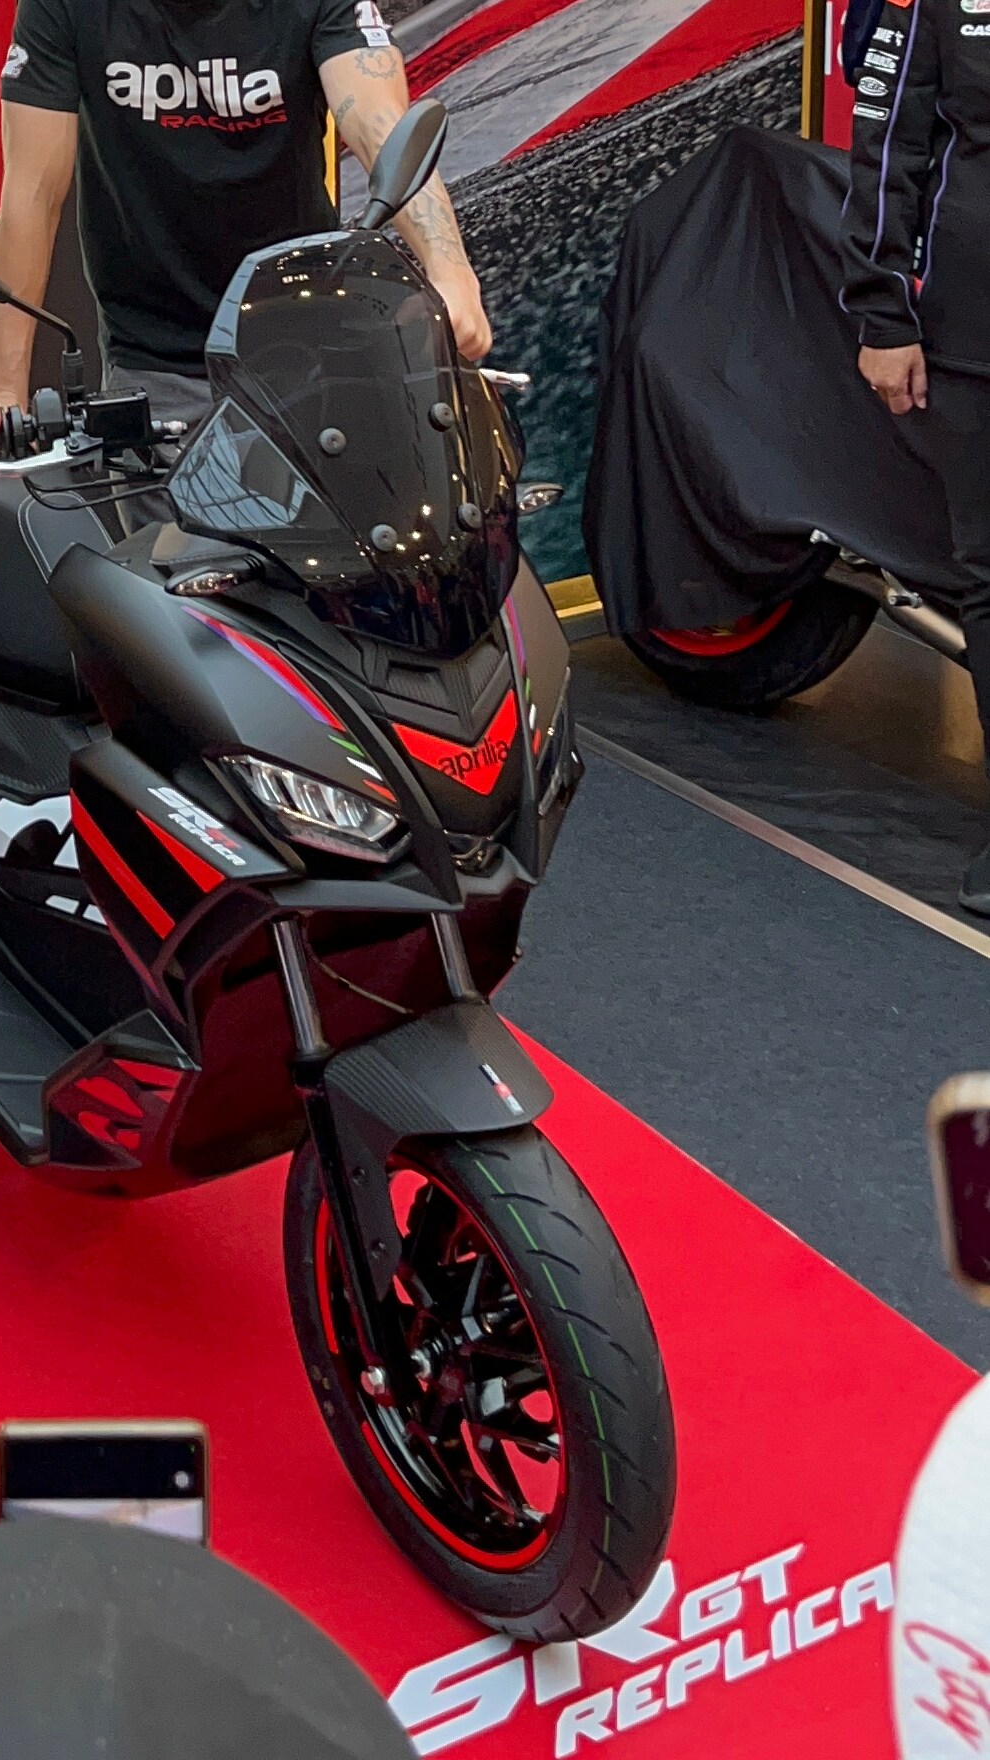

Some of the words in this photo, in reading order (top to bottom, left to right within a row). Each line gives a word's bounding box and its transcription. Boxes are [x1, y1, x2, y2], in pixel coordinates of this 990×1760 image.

[105, 56, 284, 121] aprilia
[159, 113, 288, 132] RACING
[438, 737, 510, 780] aprilia
[388, 1560, 678, 1755] SR
[680, 1543, 806, 1641] GT
[555, 1562, 895, 1759] REPLICA
